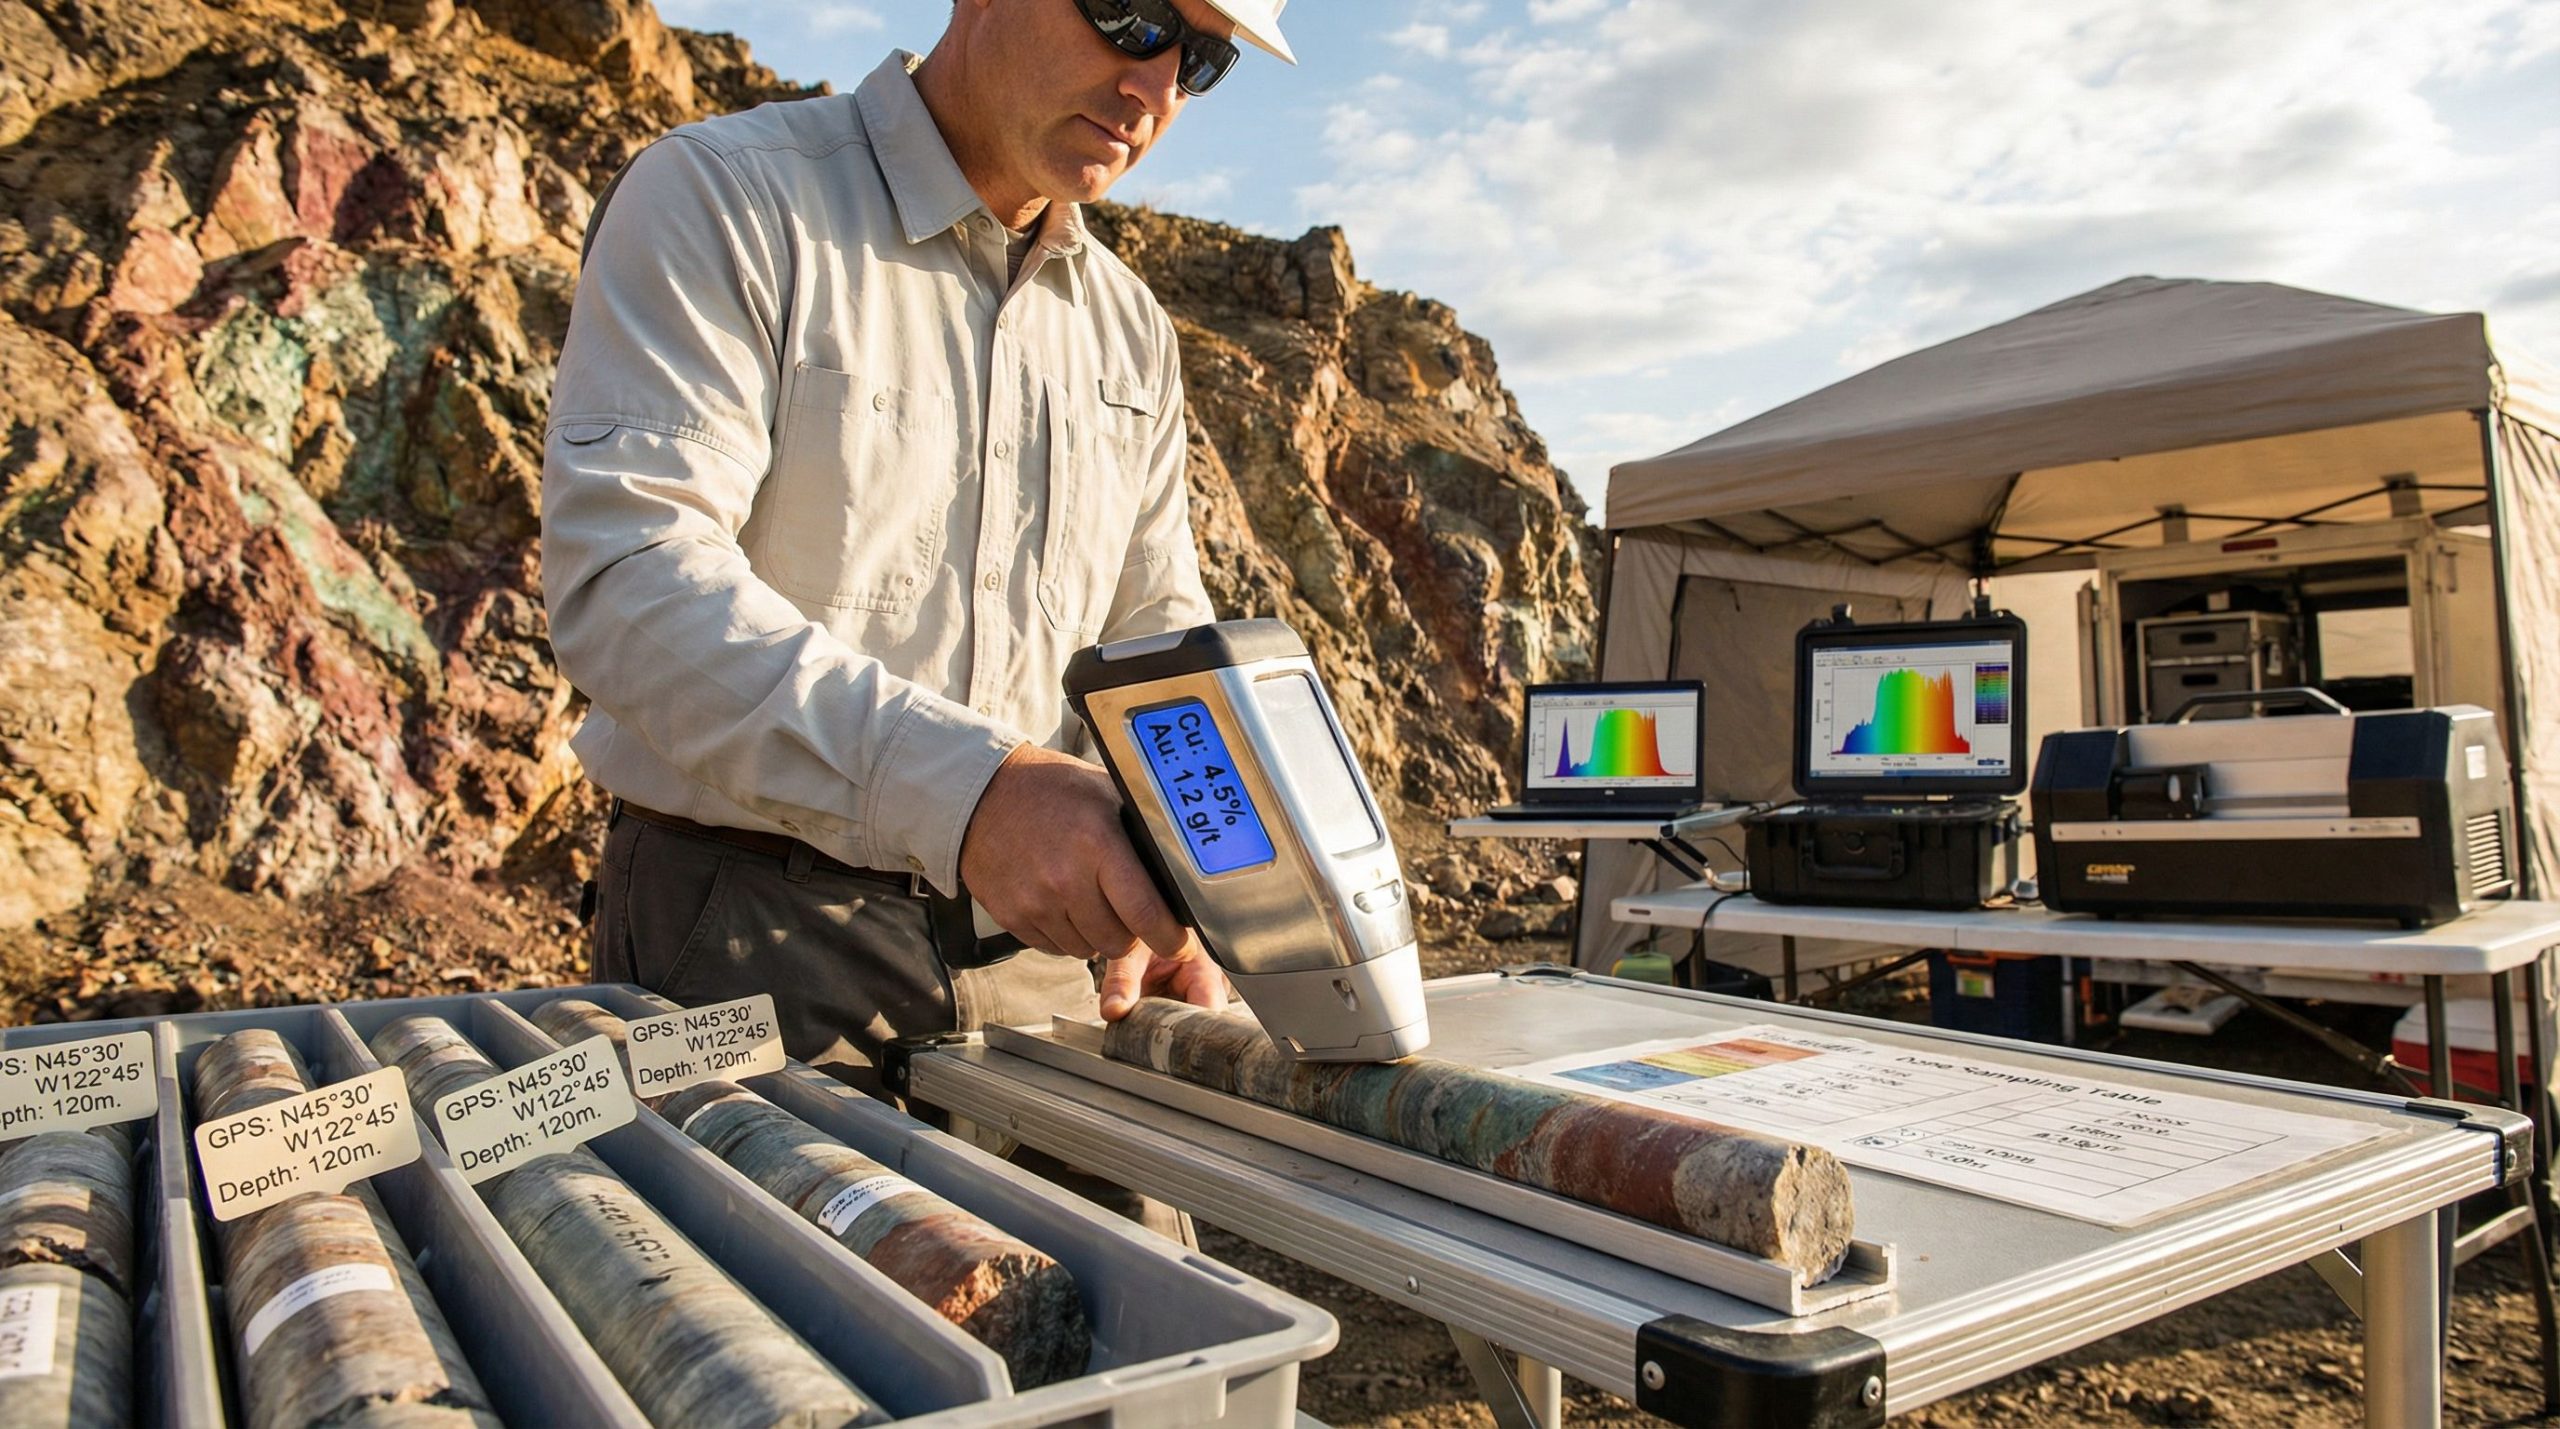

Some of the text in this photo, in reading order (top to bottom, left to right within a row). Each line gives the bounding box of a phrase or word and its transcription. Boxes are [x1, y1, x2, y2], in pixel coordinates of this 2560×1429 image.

[1148, 724, 1222, 846] Au: 1.2 g/t
[1178, 713, 1246, 826] Cu: 4.5%
[632, 1005, 752, 1044] GPS: N45°30'
[685, 1021, 770, 1053] W122°45'
[35, 1062, 144, 1096] W122°45'
[36, 1042, 124, 1073] N45°30'
[638, 1050, 757, 1086] Depth: 120m.
[53, 1092, 121, 1117] 120m.
[446, 1051, 588, 1122] GPS: N45°30'
[511, 1068, 611, 1123] W122°45'
[2088, 1087, 2162, 1105] Table
[208, 1083, 374, 1149] GPS: N45°30'
[283, 1102, 399, 1153] W122°45'
[460, 1107, 601, 1171] Depth: 120m.
[217, 1140, 382, 1204] Depth: 120m.
